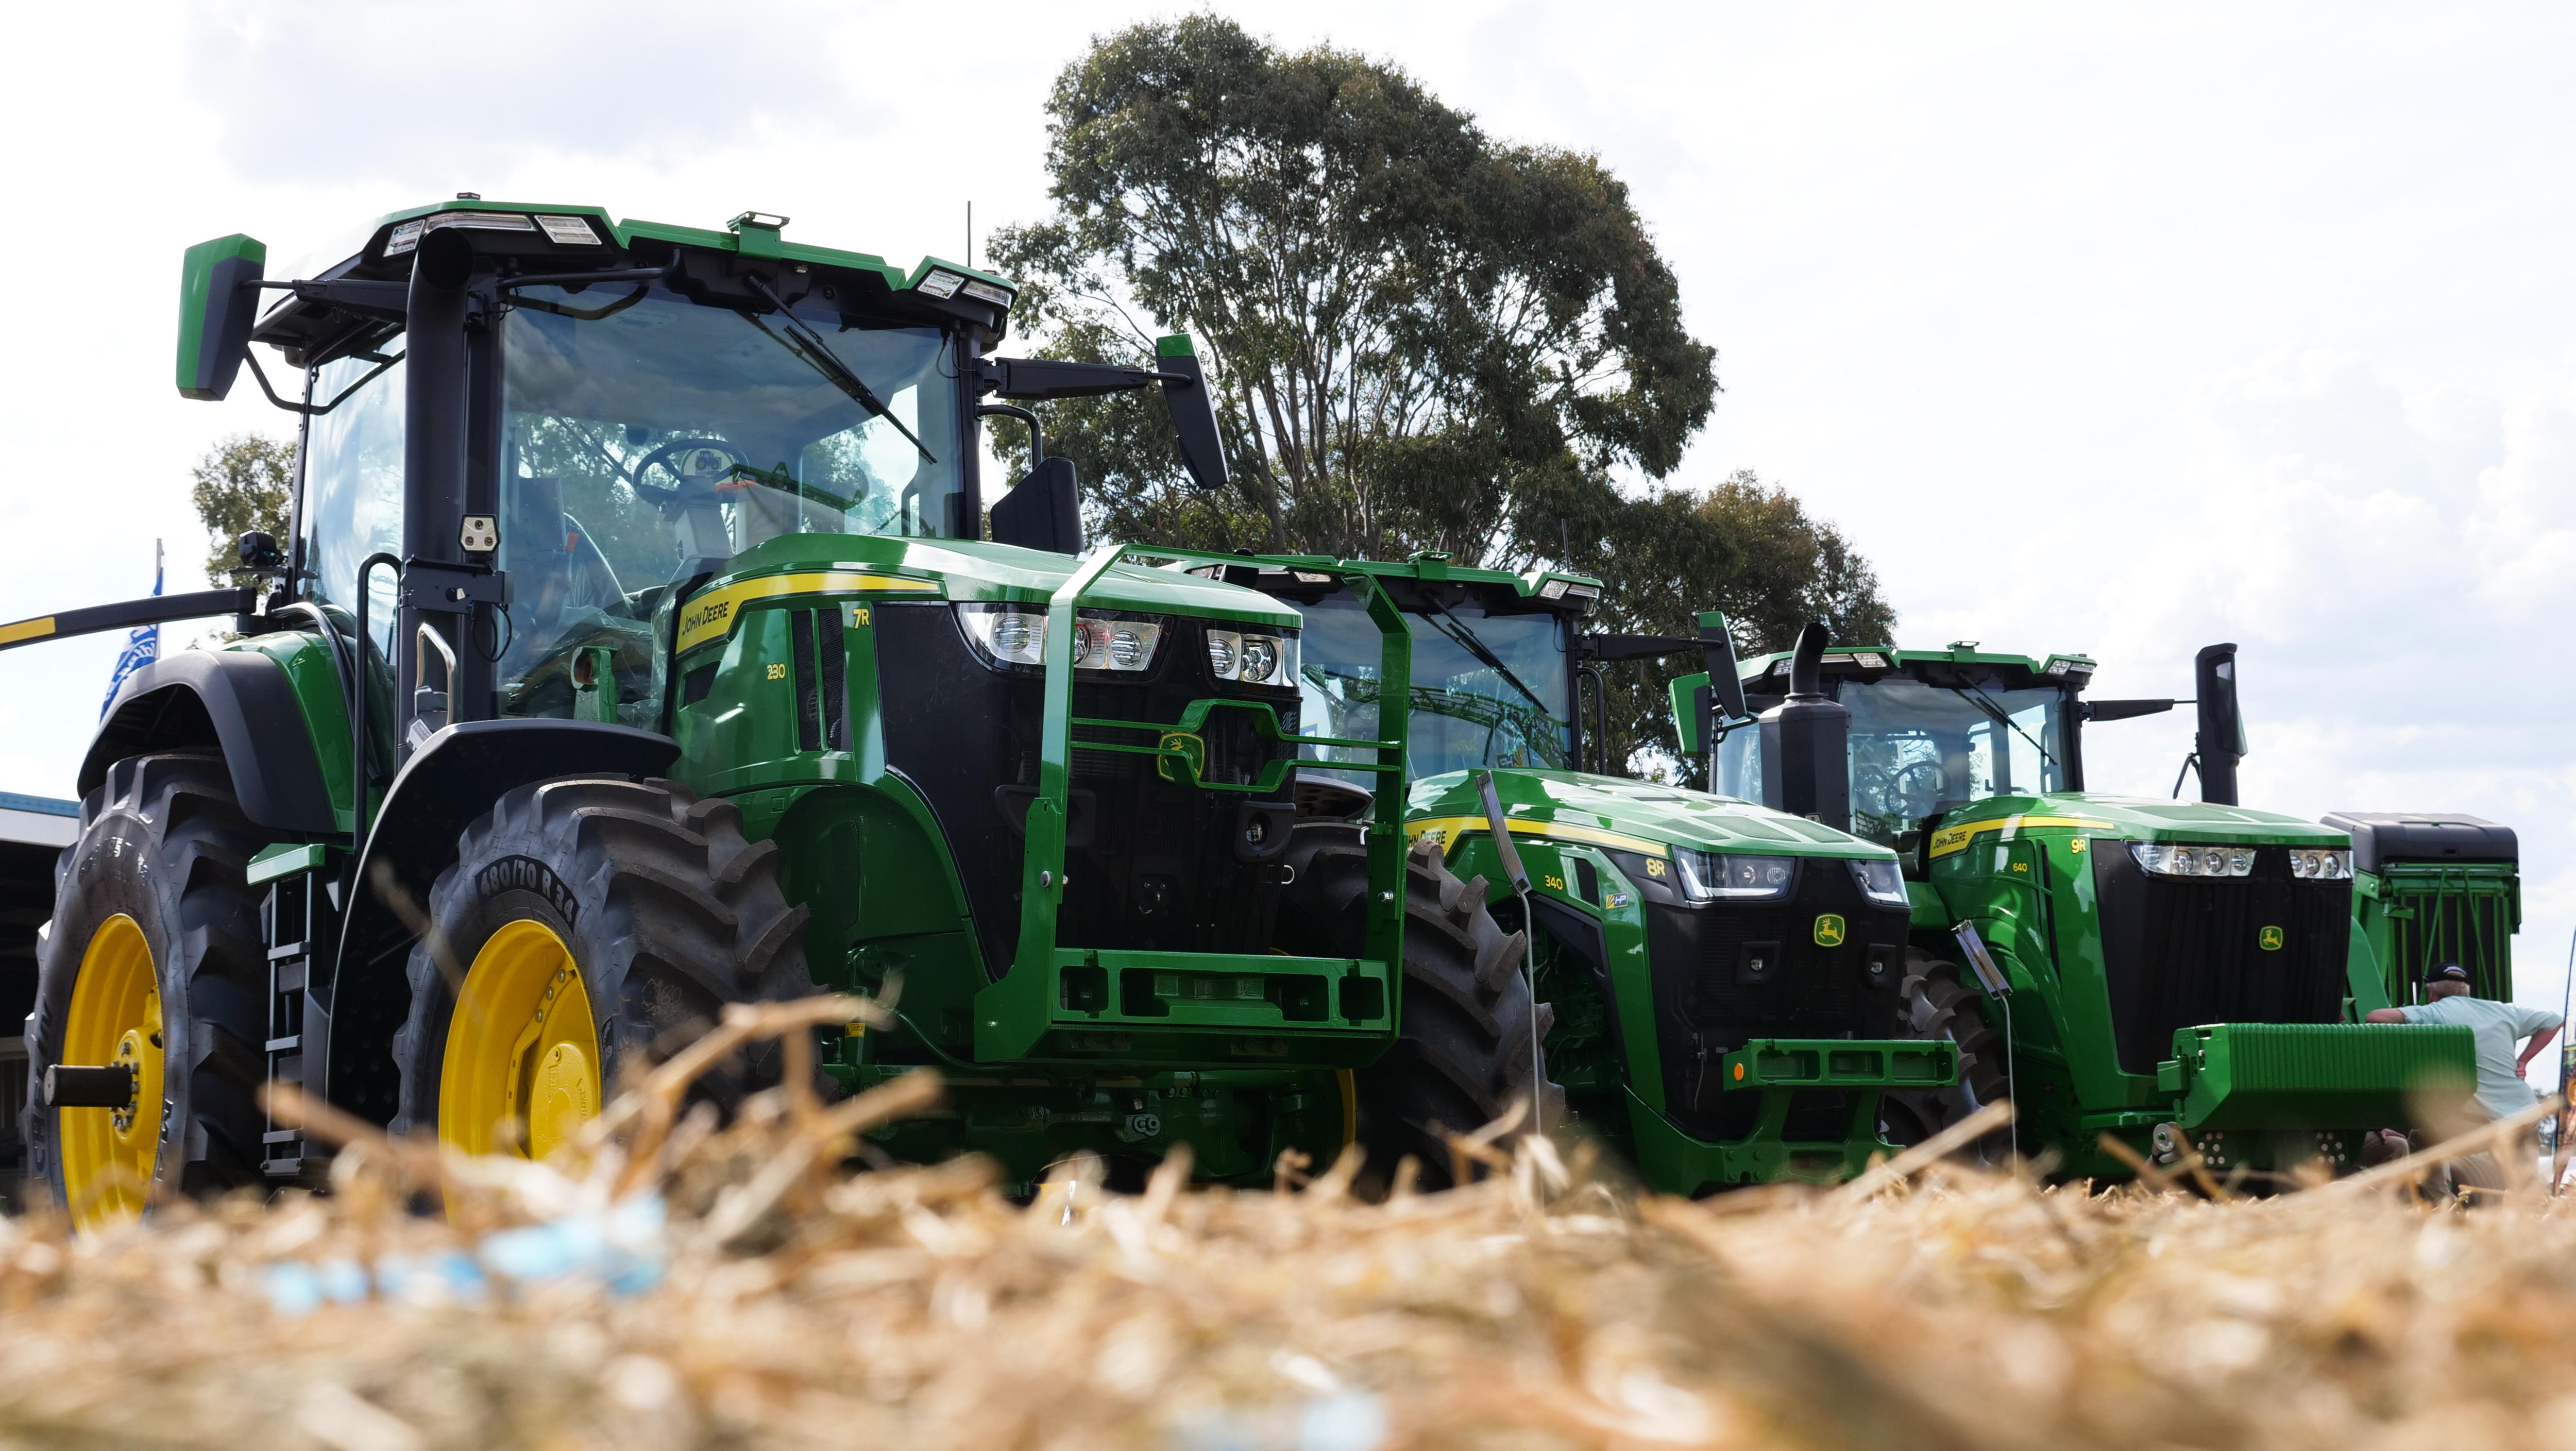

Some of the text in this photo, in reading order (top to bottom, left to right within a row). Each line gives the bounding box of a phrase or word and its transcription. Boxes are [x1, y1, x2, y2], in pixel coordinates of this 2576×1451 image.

[682, 601, 729, 636] JOHN DEERE
[853, 609, 870, 630] 7R
[766, 663, 786, 681] 230
[1408, 830, 1447, 848] HN DEERE
[1933, 831, 1967, 850] JOHN DEERE
[2071, 839, 2087, 854] 9R
[1646, 858, 1666, 876] 8R
[2012, 863, 2027, 872] 640
[481, 859, 574, 923] 480/70 R 34
[1545, 874, 1563, 891] 340
[1615, 894, 1627, 904] HP
